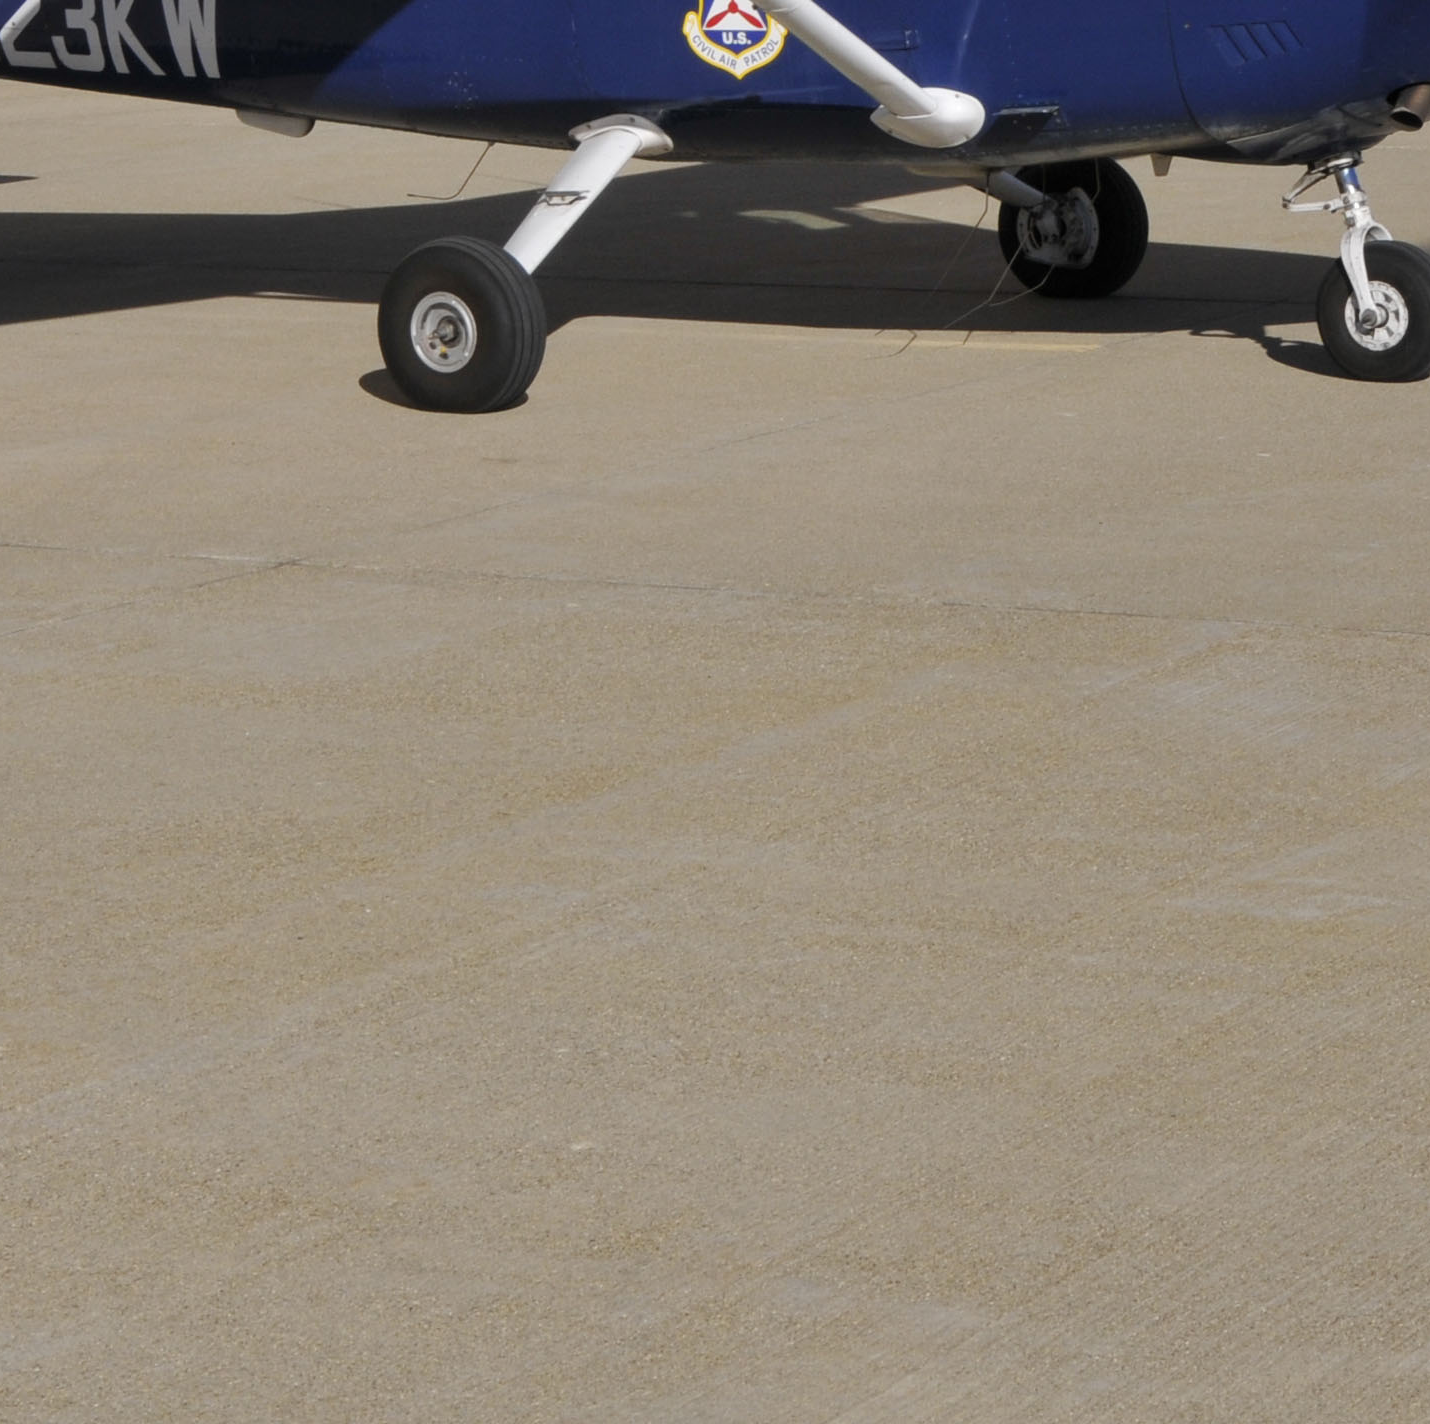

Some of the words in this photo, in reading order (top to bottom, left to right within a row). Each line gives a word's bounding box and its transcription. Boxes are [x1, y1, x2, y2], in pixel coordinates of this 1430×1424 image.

[722, 31, 752, 45] U.S.
[692, 35, 716, 60] CIVIL
[719, 54, 737, 70] AIR
[743, 39, 779, 67] PATROL
